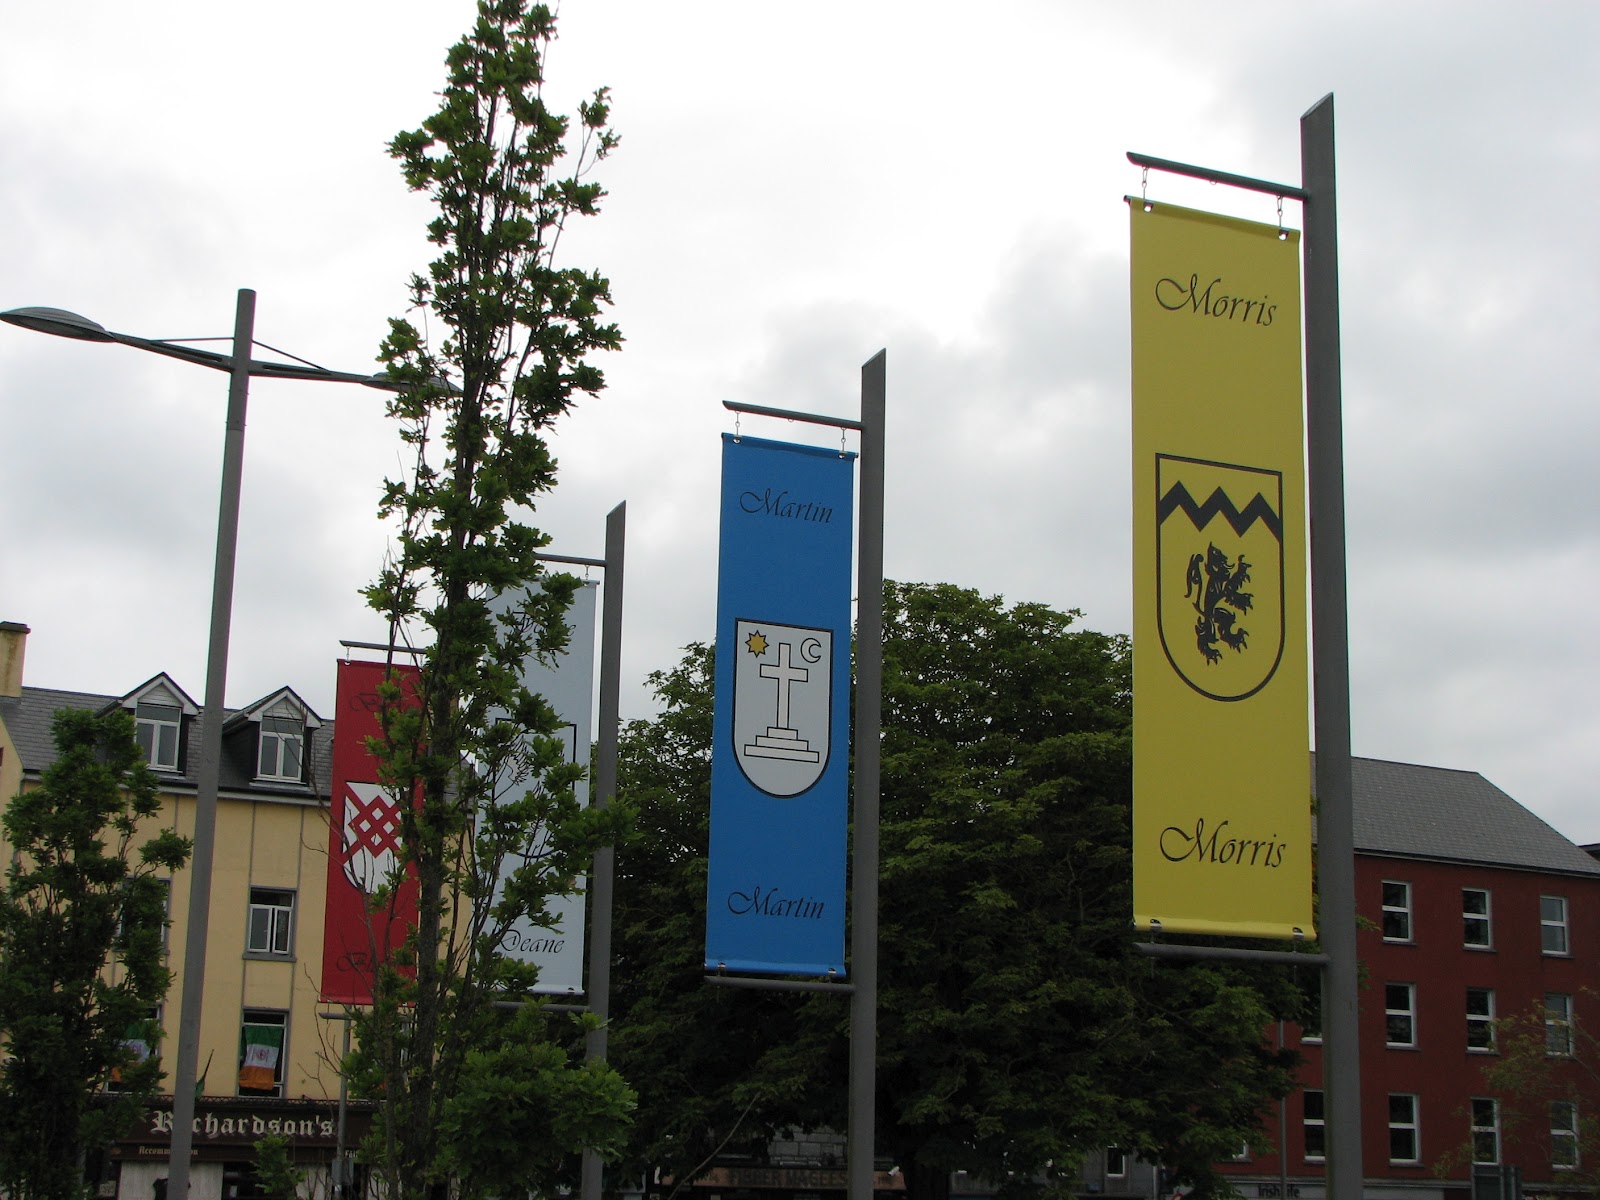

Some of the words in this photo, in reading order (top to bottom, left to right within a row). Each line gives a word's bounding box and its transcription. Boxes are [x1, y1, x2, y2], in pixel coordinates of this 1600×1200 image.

[1155, 273, 1277, 326] Morris
[739, 488, 833, 524] Martin
[1159, 817, 1287, 868] Morris
[727, 886, 825, 919] Martin
[499, 929, 565, 953] Deane
[150, 1110, 334, 1139] Rchardson's
[138, 1146, 199, 1156] Accommon
